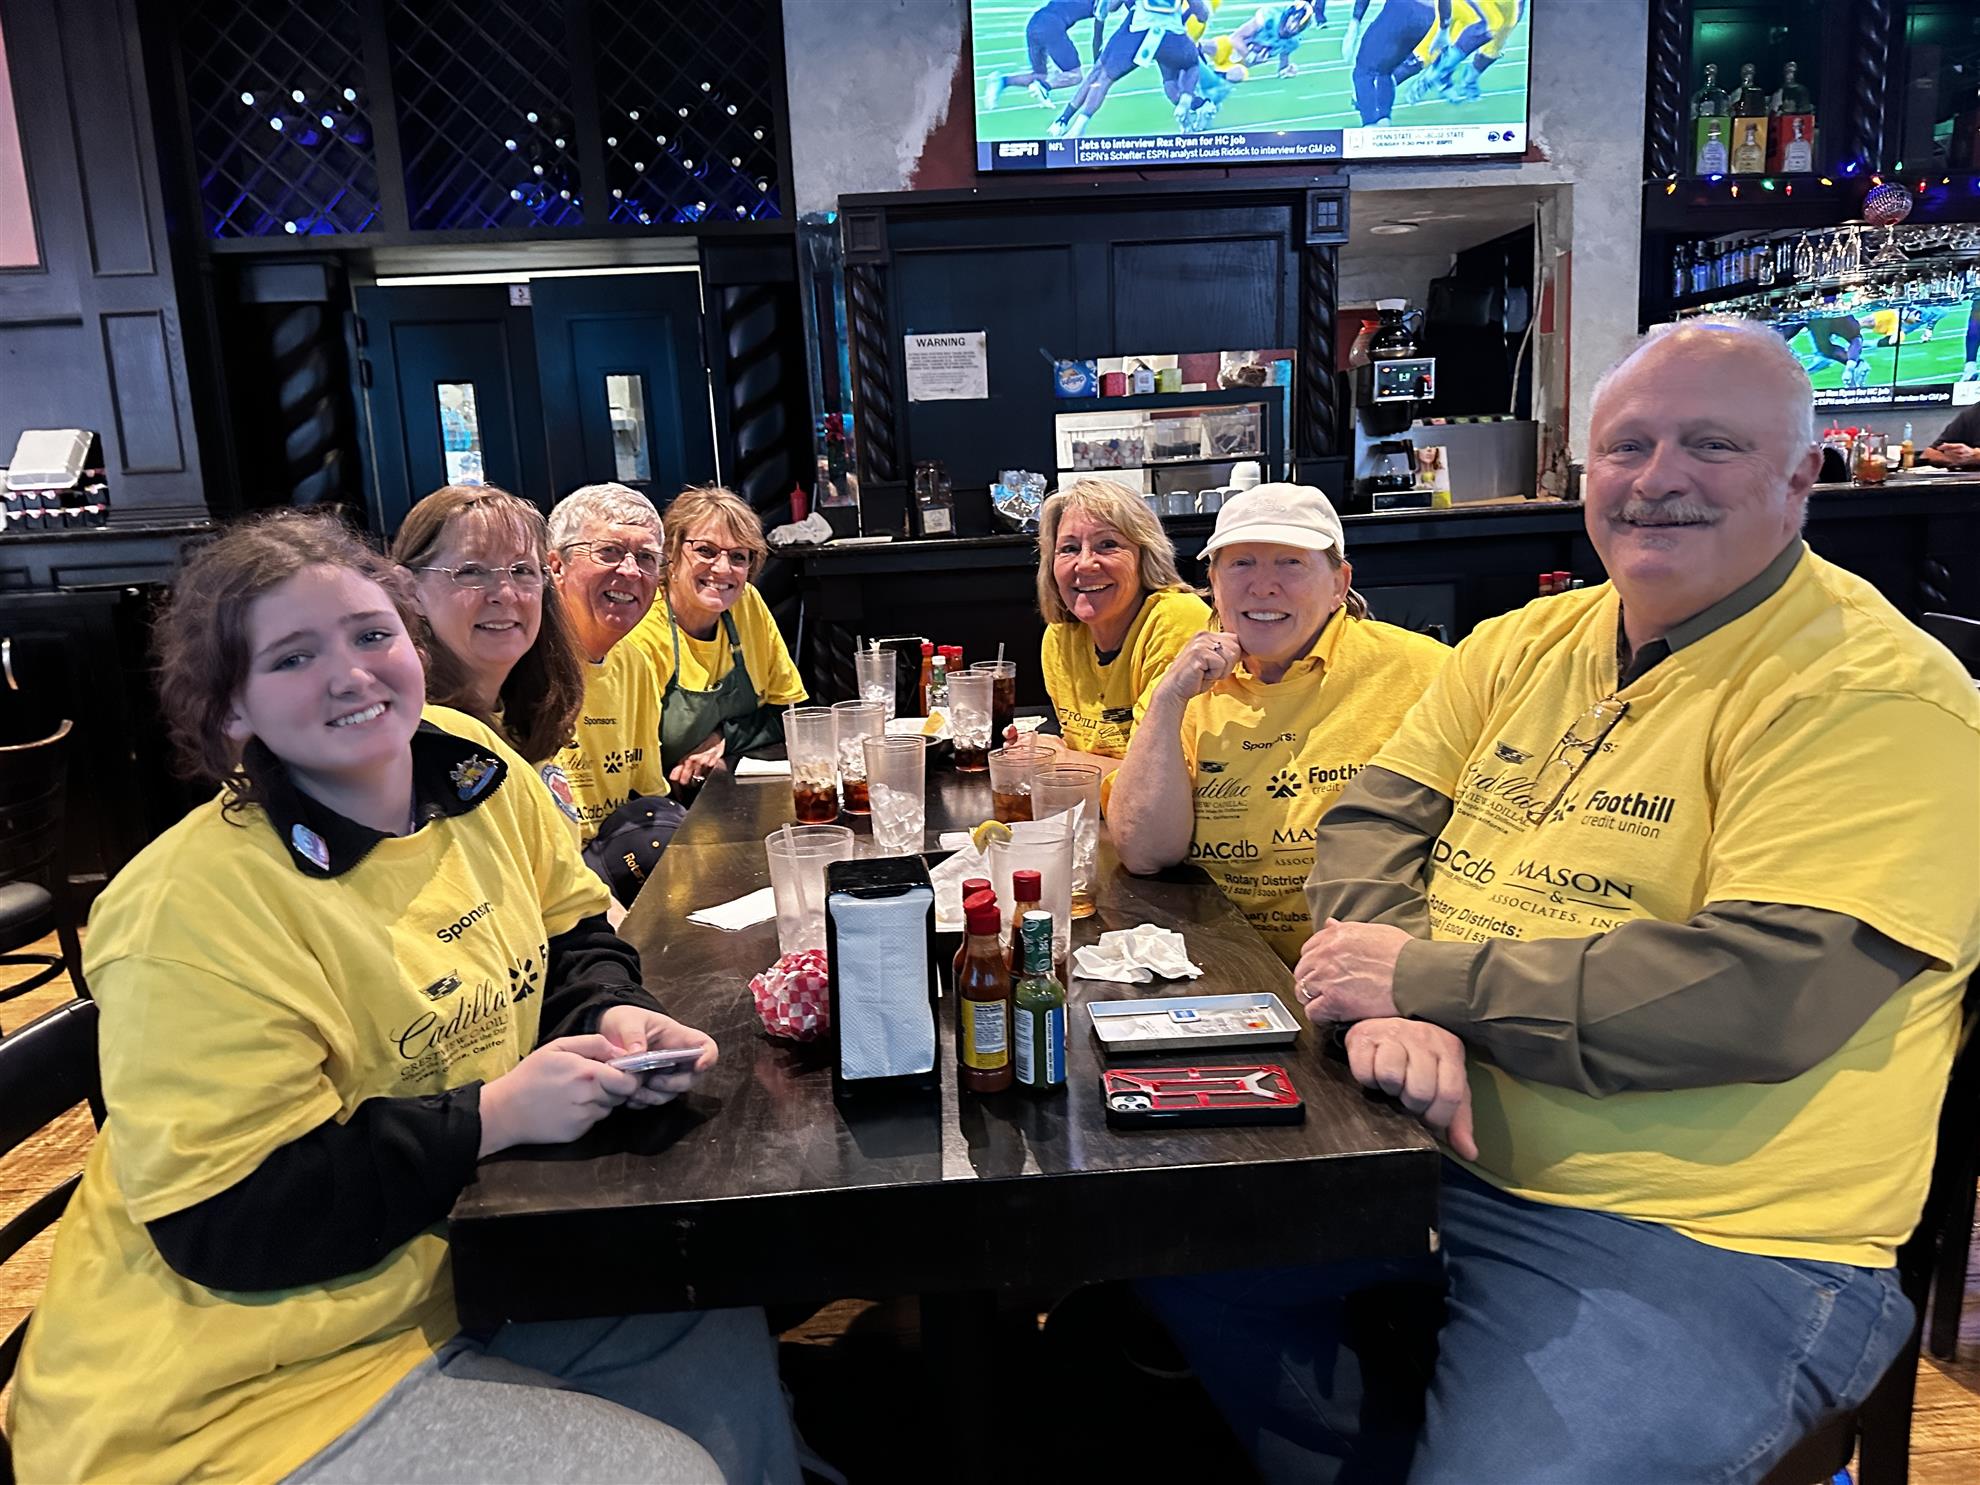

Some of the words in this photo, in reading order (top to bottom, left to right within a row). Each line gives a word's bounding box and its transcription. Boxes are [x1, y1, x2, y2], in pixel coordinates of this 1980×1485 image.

[998, 142, 1040, 157] ESPN
[1048, 142, 1065, 151] NFL
[1079, 139, 1099, 150] Jets
[1101, 140, 1112, 150] to
[1113, 138, 1155, 149] interview
[1156, 137, 1174, 148] Rex
[1175, 136, 1198, 149] Ryan
[1199, 136, 1214, 146] for
[1215, 135, 1229, 145] HC
[1229, 134, 1246, 147] job
[1080, 150, 1109, 162] ESPN's
[1110, 148, 1146, 161] Schefter:
[1147, 149, 1169, 159] ESPN
[1170, 148, 1198, 160] analyst
[1199, 147, 1220, 158] Louis
[1221, 146, 1250, 157] Riddick
[1251, 147, 1259, 156] to
[1260, 145, 1296, 156] interview
[1296, 145, 1308, 154] for
[1308, 144, 1322, 153] GM
[1322, 144, 1337, 155] job
[916, 337, 966, 347] WARNING
[1585, 790, 1676, 823] Foothill
[1580, 814, 1616, 830] credit
[1617, 820, 1661, 839] union
[1224, 873, 1259, 887] Rotary
[1510, 859, 1635, 899] MASON
[1550, 890, 1565, 905] &
[1457, 908, 1523, 938] Districts:
